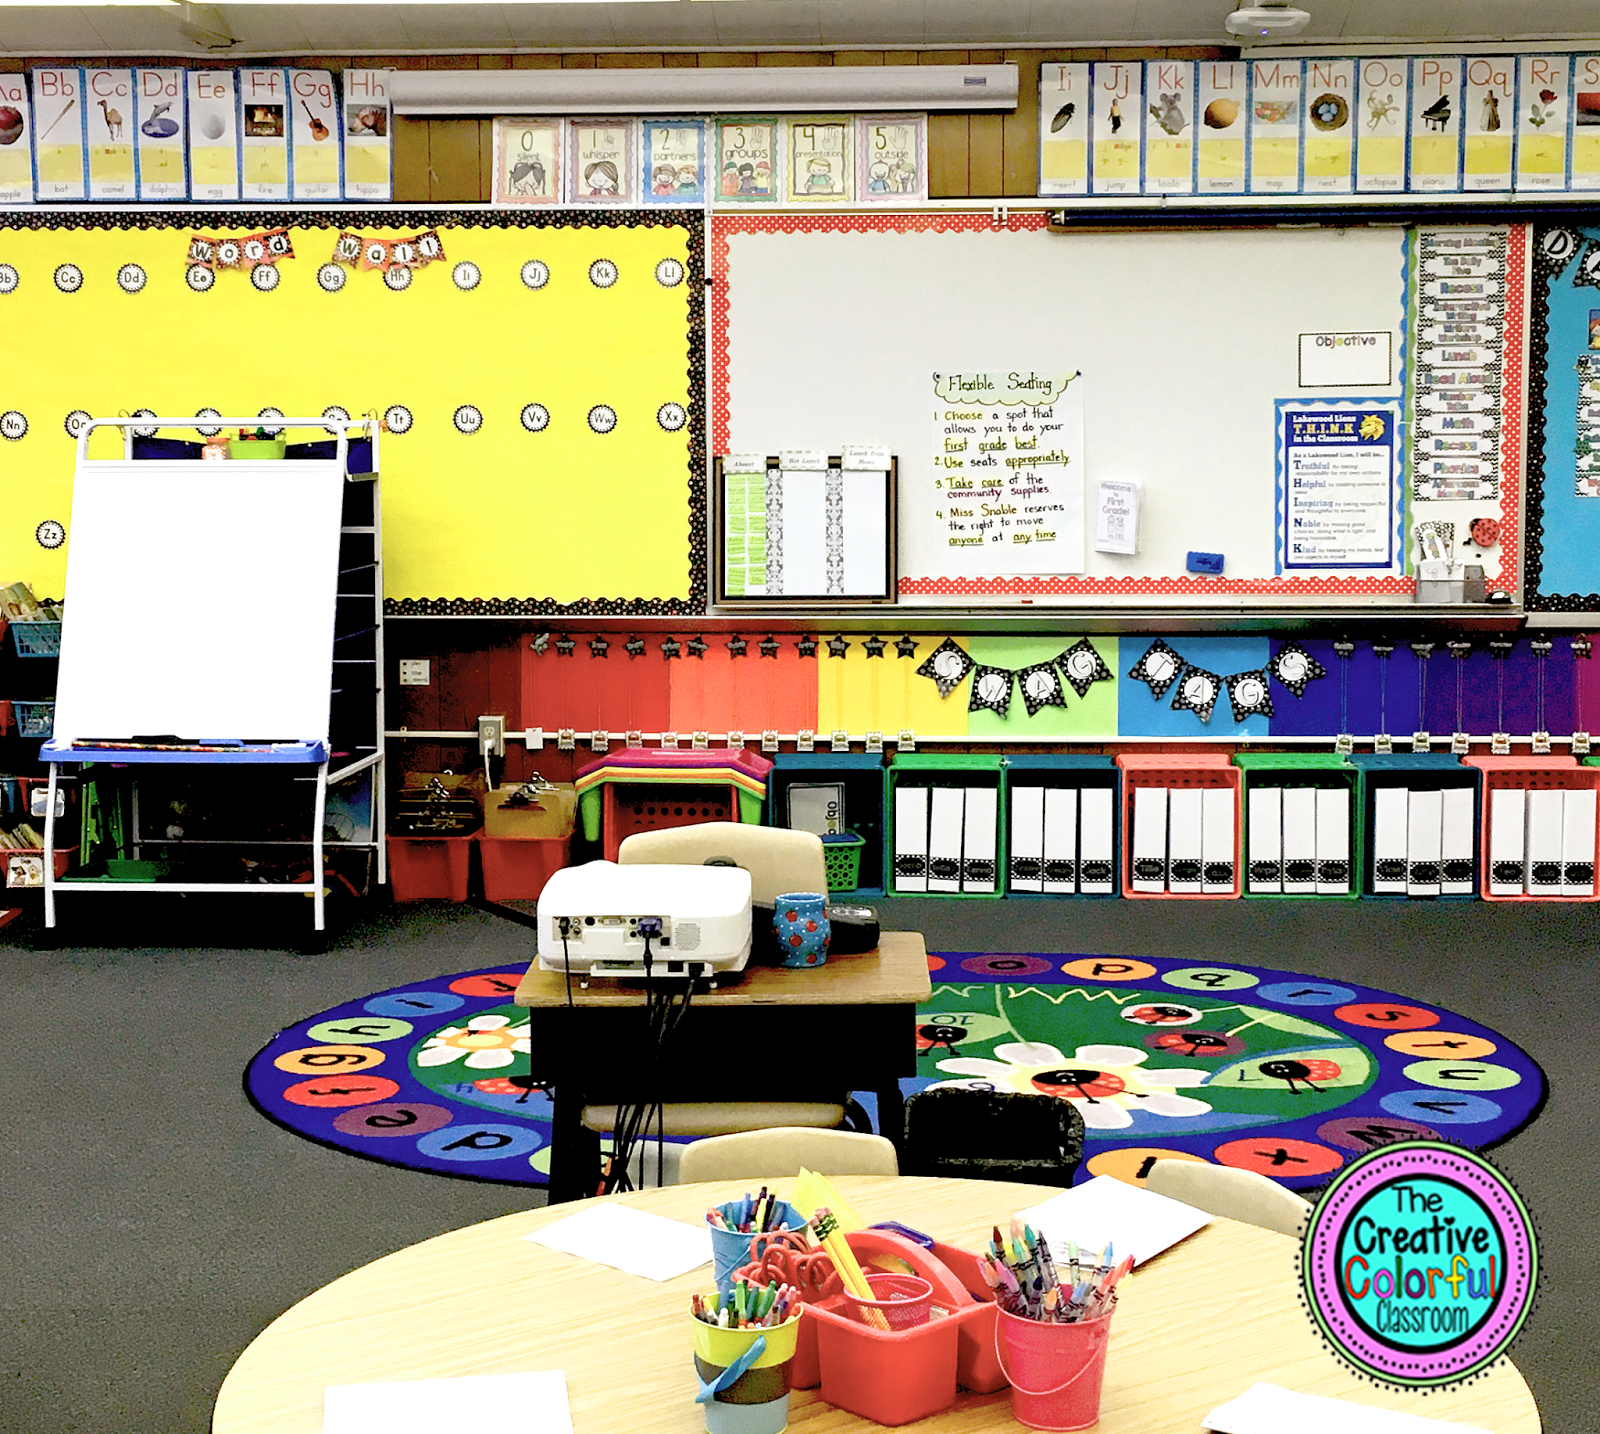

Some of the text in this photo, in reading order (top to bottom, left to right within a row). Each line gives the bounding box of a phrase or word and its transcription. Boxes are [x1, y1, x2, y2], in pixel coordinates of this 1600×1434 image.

[1158, 65, 1184, 90] Kk
[1213, 65, 1234, 89] Ll
[1254, 65, 1299, 89] Mm
[1313, 63, 1347, 88] Nn
[1364, 62, 1403, 87] Oo
[1531, 59, 1561, 84] Rr
[41, 72, 74, 97] Bb
[91, 72, 128, 97] Cc
[142, 72, 178, 97] Dd
[251, 72, 279, 96] Ff
[350, 73, 385, 97] Hh
[1057, 66, 1072, 92] Ii
[1104, 65, 1128, 100] Jj
[1422, 61, 1453, 96] Pp
[1469, 60, 1513, 97] Qq
[197, 74, 226, 99] Ee
[293, 73, 332, 108] Gg
[661, 129, 670, 150] 2
[733, 127, 745, 149] 3
[803, 127, 814, 150] 4
[876, 127, 887, 150] 5
[583, 150, 620, 162] whisper
[653, 151, 697, 162] partners
[725, 148, 768, 162] groups
[795, 150, 842, 161] presentation
[875, 149, 908, 161] outside
[1106, 181, 1126, 191] jump
[1209, 180, 1233, 188] lemon
[1266, 181, 1283, 189] map
[1318, 179, 1337, 187] nest
[1364, 177, 1397, 187] octopus
[1422, 178, 1446, 187] piano
[1474, 177, 1501, 187] queen
[1531, 177, 1551, 185] rose
[54, 184, 68, 194] bat
[101, 184, 125, 194] camel
[207, 188, 223, 198] egg
[258, 184, 273, 194] fire
[356, 184, 379, 197] hippo
[61, 272, 76, 284] Cc
[124, 272, 139, 283] Dd
[194, 270, 208, 283] Ee
[258, 272, 271, 282] Ff
[324, 272, 339, 286] Gg
[390, 271, 405, 282] Hh
[529, 268, 541, 281] Jj
[596, 267, 610, 278] Kk
[1440, 282, 1483, 294] Recess
[1316, 336, 1376, 349] Objective
[1442, 349, 1477, 361] Lunch
[949, 372, 1052, 395] Flexible Seating
[1425, 372, 1494, 385] Read Aloud
[460, 413, 476, 424] Uu
[528, 412, 542, 422] Vv
[594, 413, 612, 425] Ww
[665, 411, 678, 422] Xx
[945, 411, 983, 420] Choose
[1006, 408, 1027, 422] spot
[1032, 406, 1053, 419] that
[6, 420, 20, 430] Nn
[1442, 417, 1475, 429] Math
[944, 422, 1064, 438] allows you to do your
[944, 437, 968, 451] first
[979, 436, 1007, 454] grade
[1435, 439, 1477, 451] Recess
[944, 457, 963, 468] Use
[970, 454, 998, 467] seats
[1293, 460, 1330, 470] Truthful
[1434, 462, 1479, 474] Phonics
[945, 472, 1044, 489] Take care of the
[1293, 478, 1326, 489] Helpful
[947, 488, 1002, 502] community
[1294, 497, 1333, 508] Inspiring
[950, 503, 1064, 517] Miss Snable reserves
[949, 517, 1044, 535] the right to move
[1293, 518, 1321, 527] Noble
[44, 529, 57, 539] Zz
[949, 536, 984, 547] anyone
[992, 532, 1003, 542] at
[1013, 534, 1032, 544] any
[1293, 544, 1316, 553] Kind
